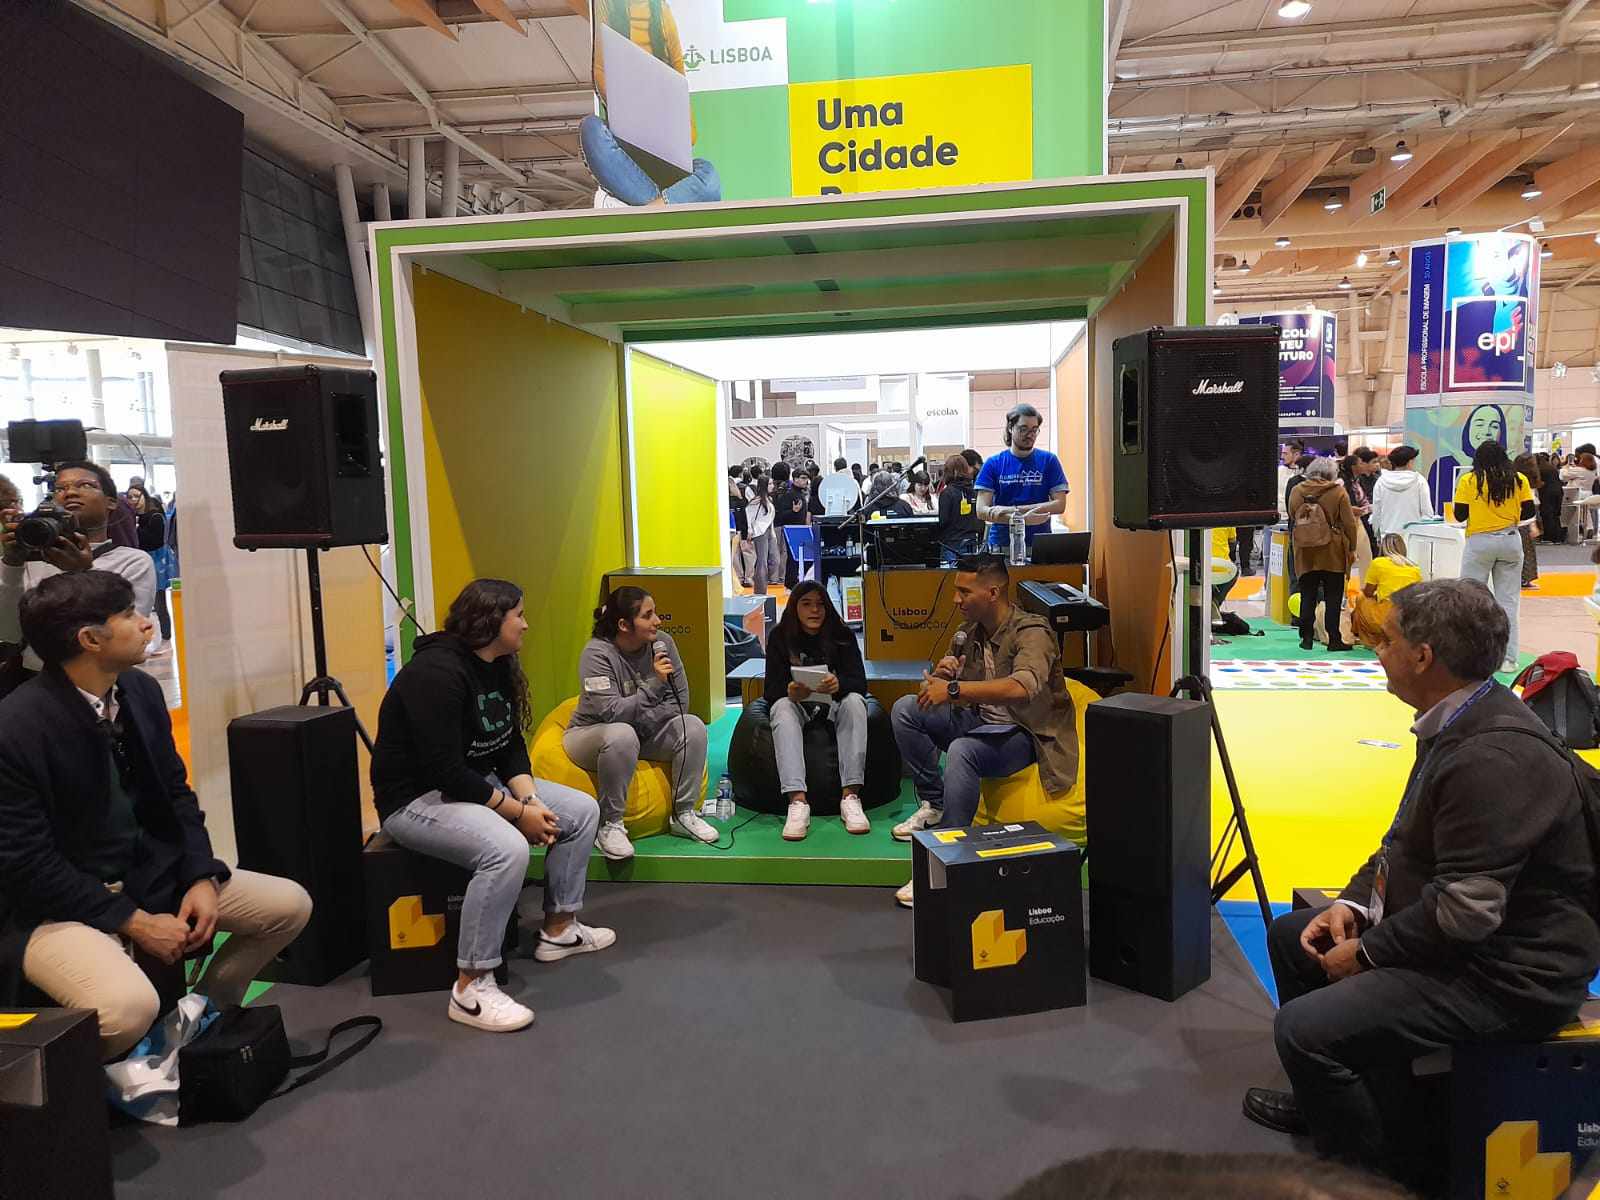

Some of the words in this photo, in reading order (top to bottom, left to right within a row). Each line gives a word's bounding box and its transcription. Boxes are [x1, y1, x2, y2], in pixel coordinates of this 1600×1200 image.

[710, 46, 773, 65] LISBOA
[817, 98, 903, 131] Uma
[818, 135, 959, 174] Cidade
[1477, 326, 1516, 357] epi
[1192, 378, 1245, 395] Marshall
[926, 407, 959, 417] escolas
[250, 417, 289, 431] Marshall
[892, 607, 928, 616] Lisboa
[1028, 906, 1052, 916] Lisboa
[1029, 914, 1065, 925] Educação
